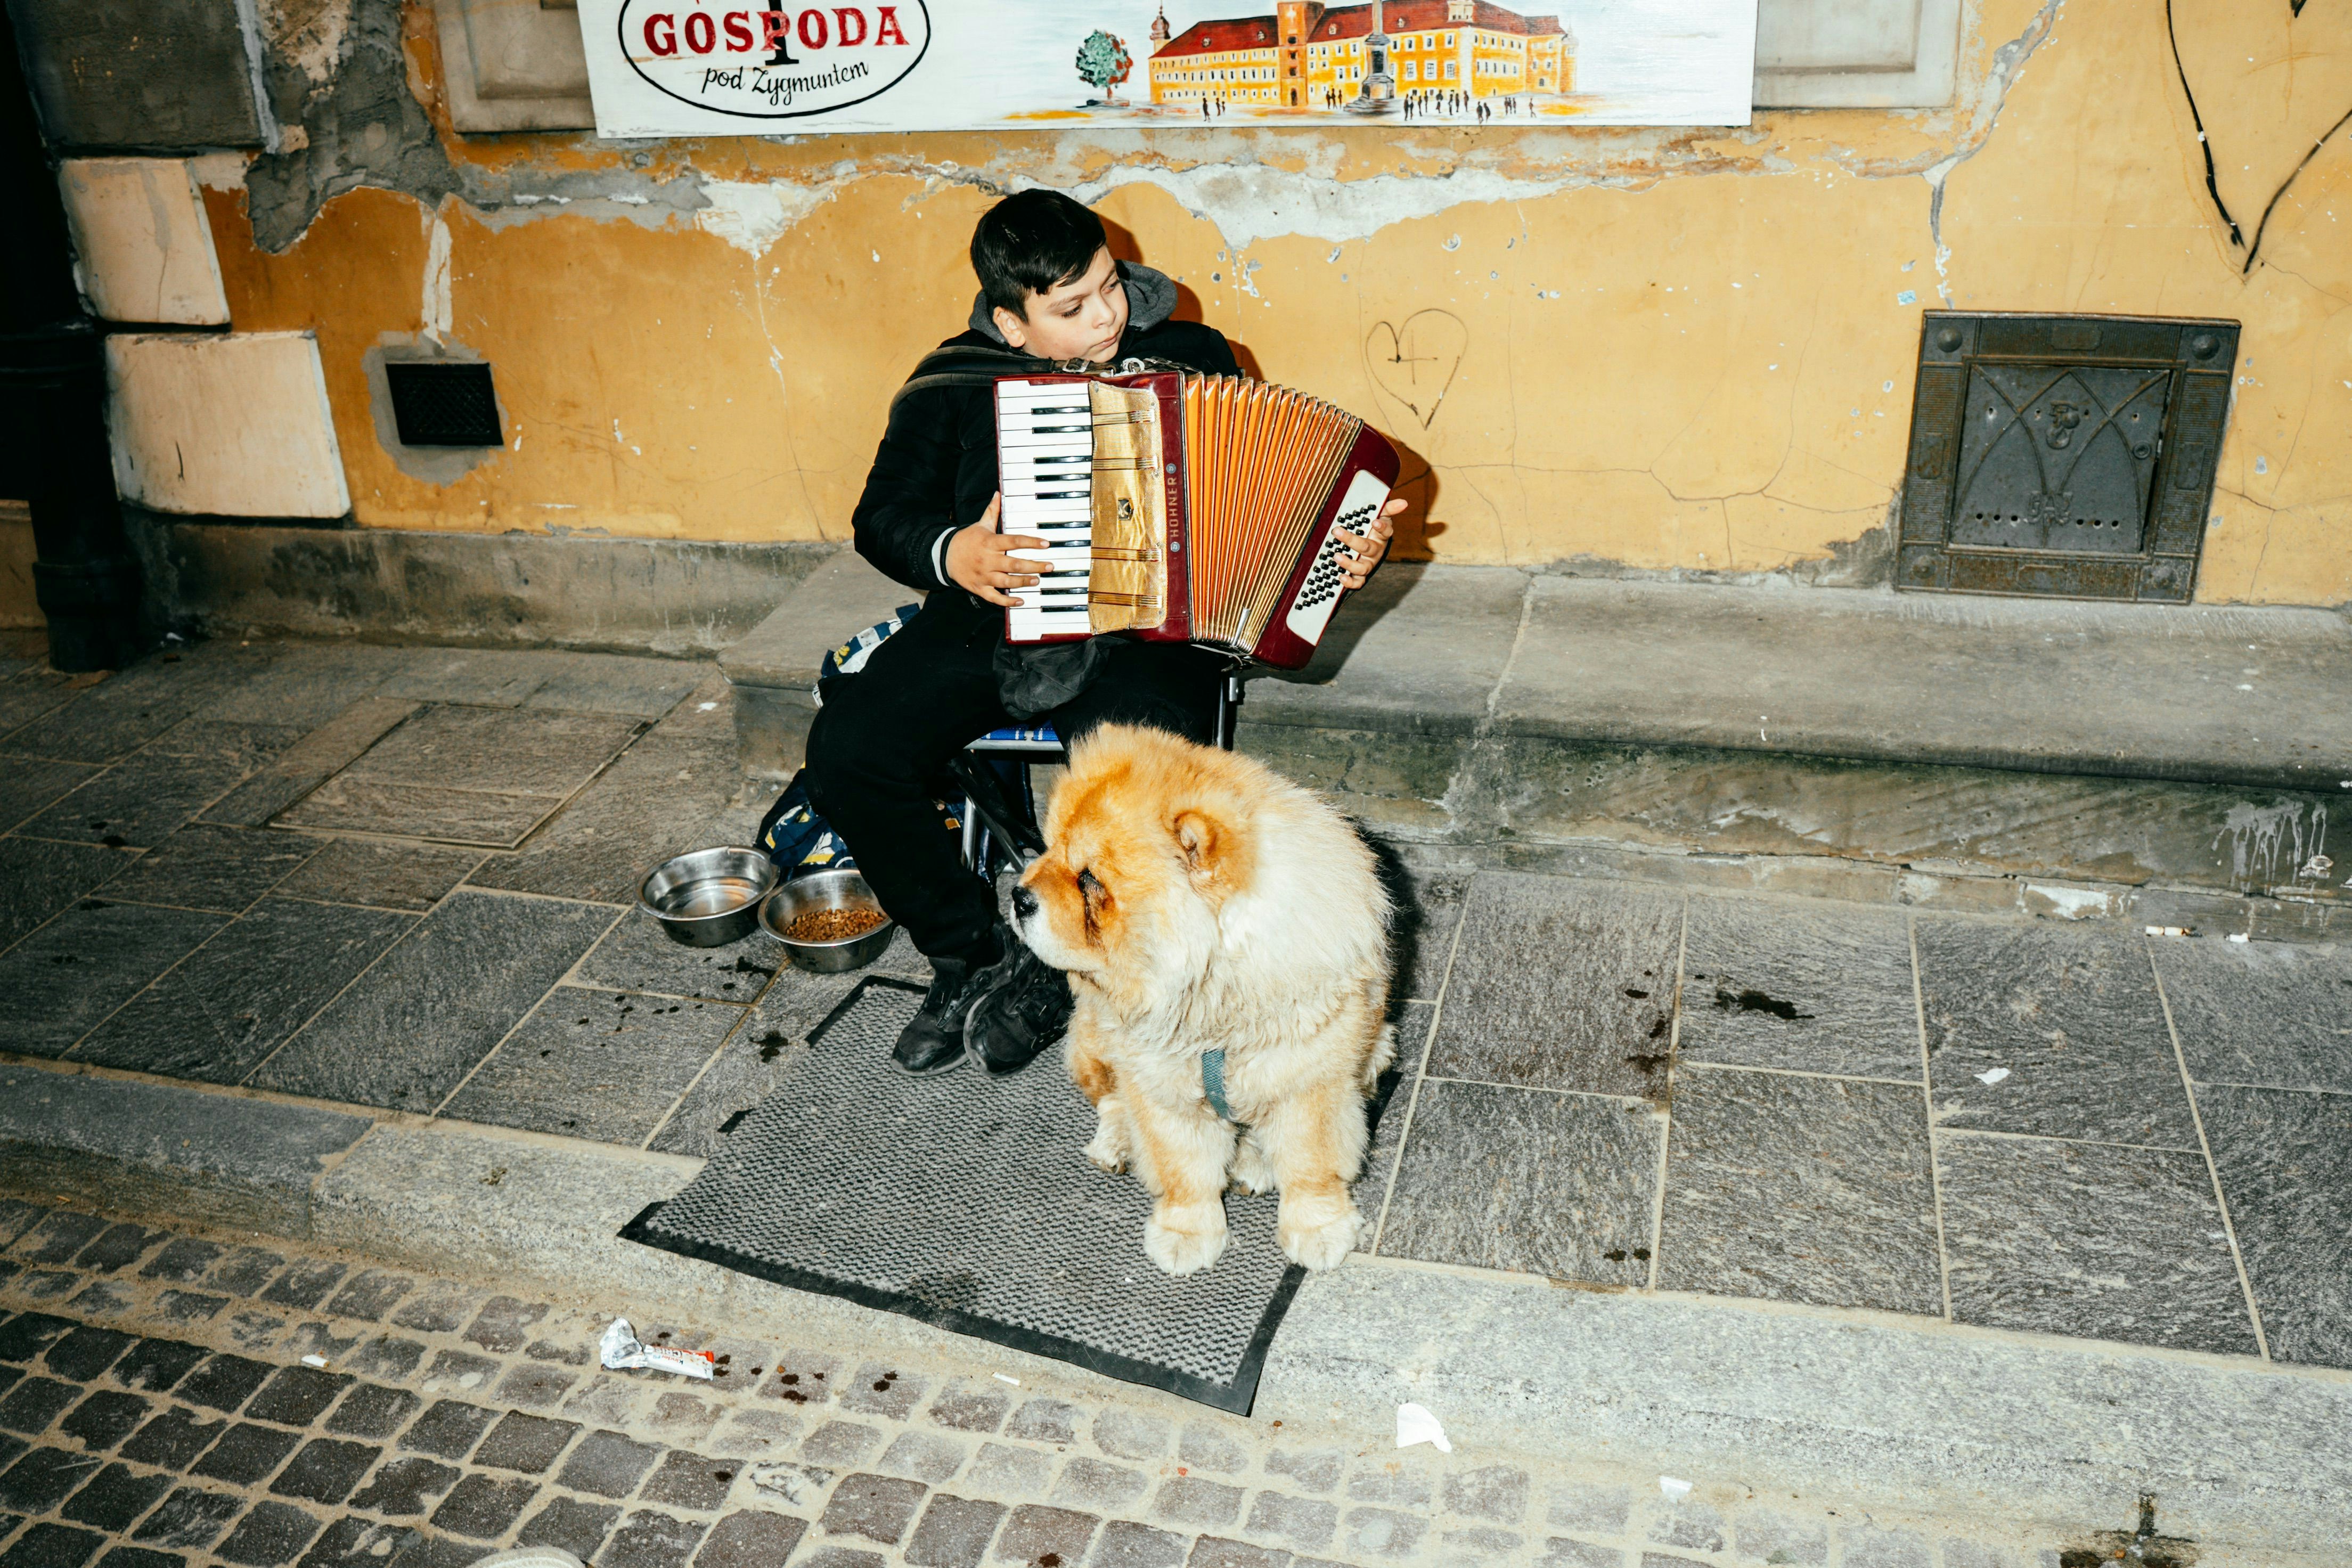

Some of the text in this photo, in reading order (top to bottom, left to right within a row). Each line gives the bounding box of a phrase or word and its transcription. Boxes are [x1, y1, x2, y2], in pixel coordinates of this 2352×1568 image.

[643, 6, 910, 56] GOSPODA
[701, 61, 869, 105] pod Zygmuntem
[1167, 477, 1179, 537] HOHNER
